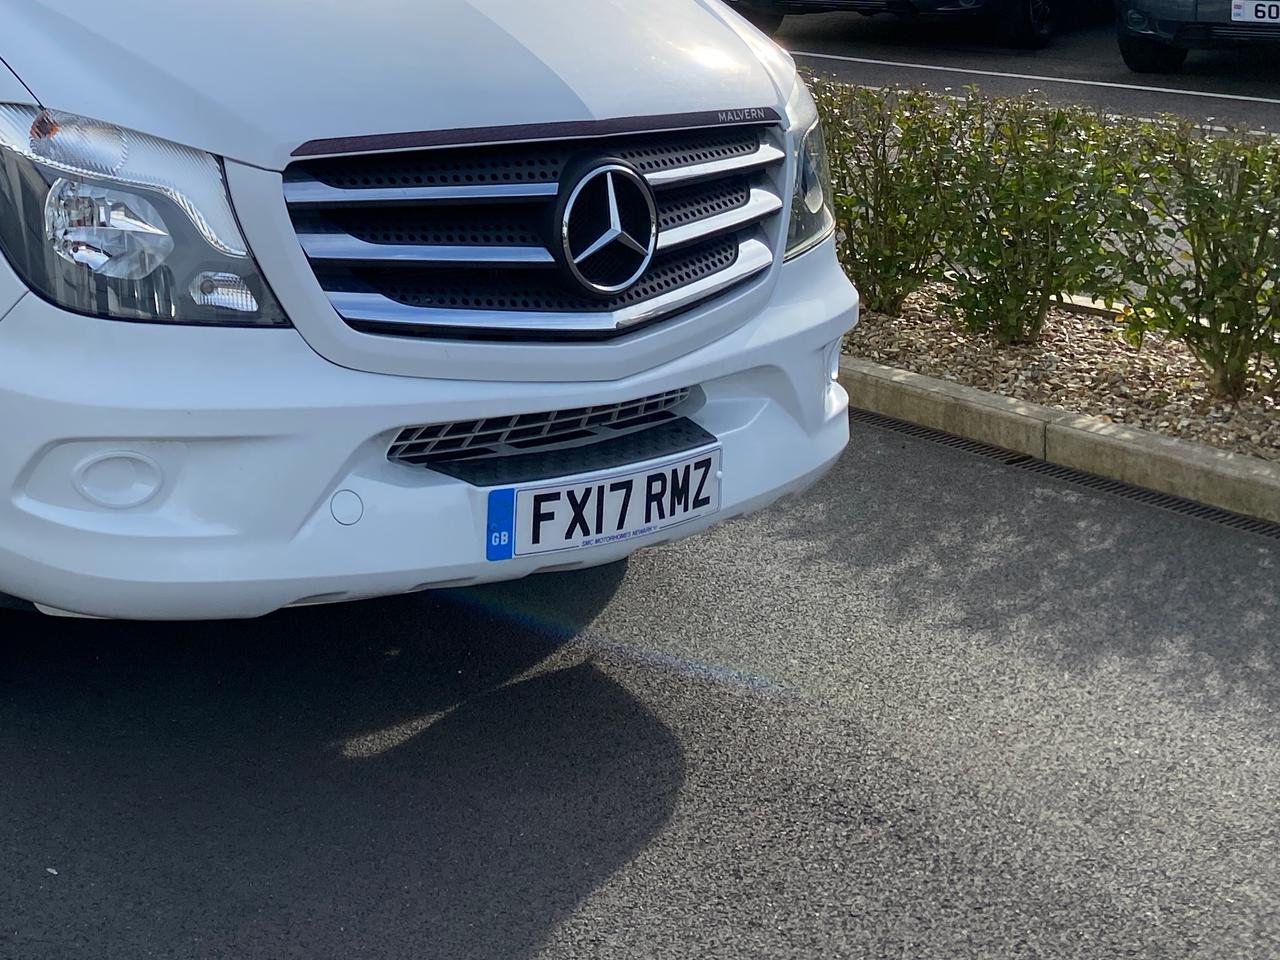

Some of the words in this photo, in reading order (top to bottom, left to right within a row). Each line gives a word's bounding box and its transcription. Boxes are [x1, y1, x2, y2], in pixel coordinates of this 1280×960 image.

[718, 108, 765, 122] MALVERN
[531, 479, 634, 545] FX17
[645, 457, 712, 524] RMZ
[491, 530, 509, 545] GB
